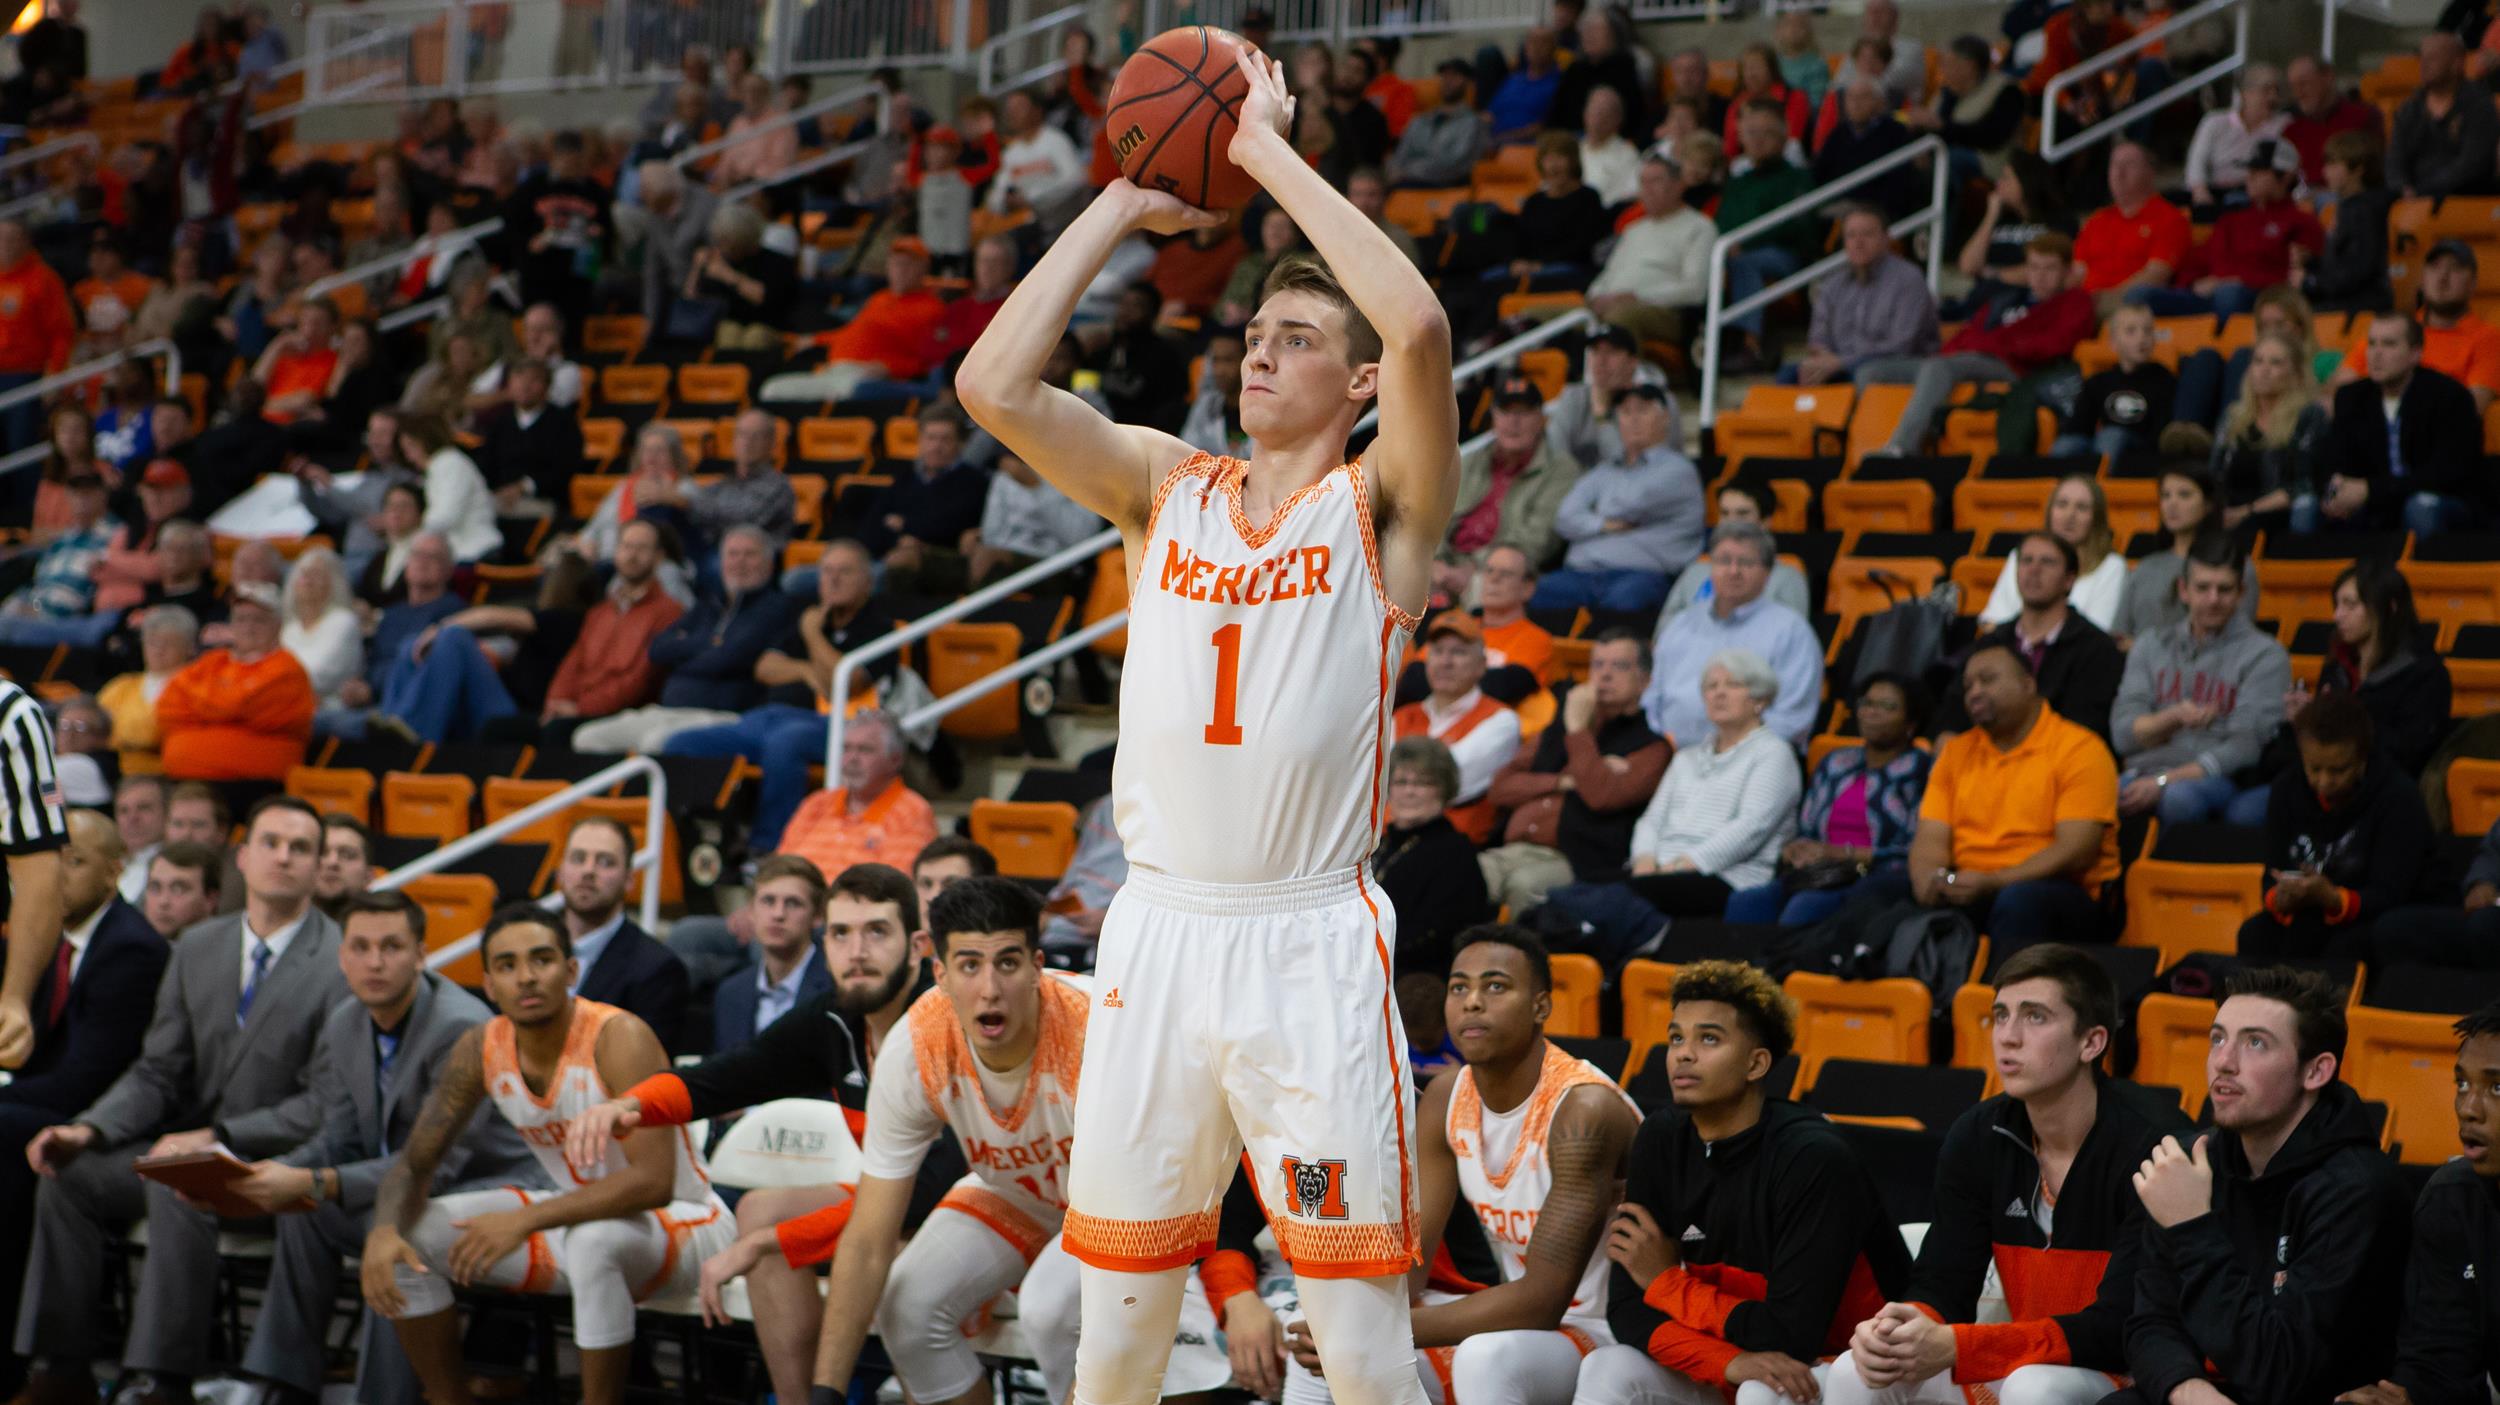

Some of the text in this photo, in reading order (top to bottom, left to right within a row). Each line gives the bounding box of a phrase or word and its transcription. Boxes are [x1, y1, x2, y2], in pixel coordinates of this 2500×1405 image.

[1160, 539, 1332, 606] MERCER
[1204, 623, 1242, 745] 1
[965, 1131, 1074, 1170] MERCE
[1279, 1153, 1349, 1220] M
